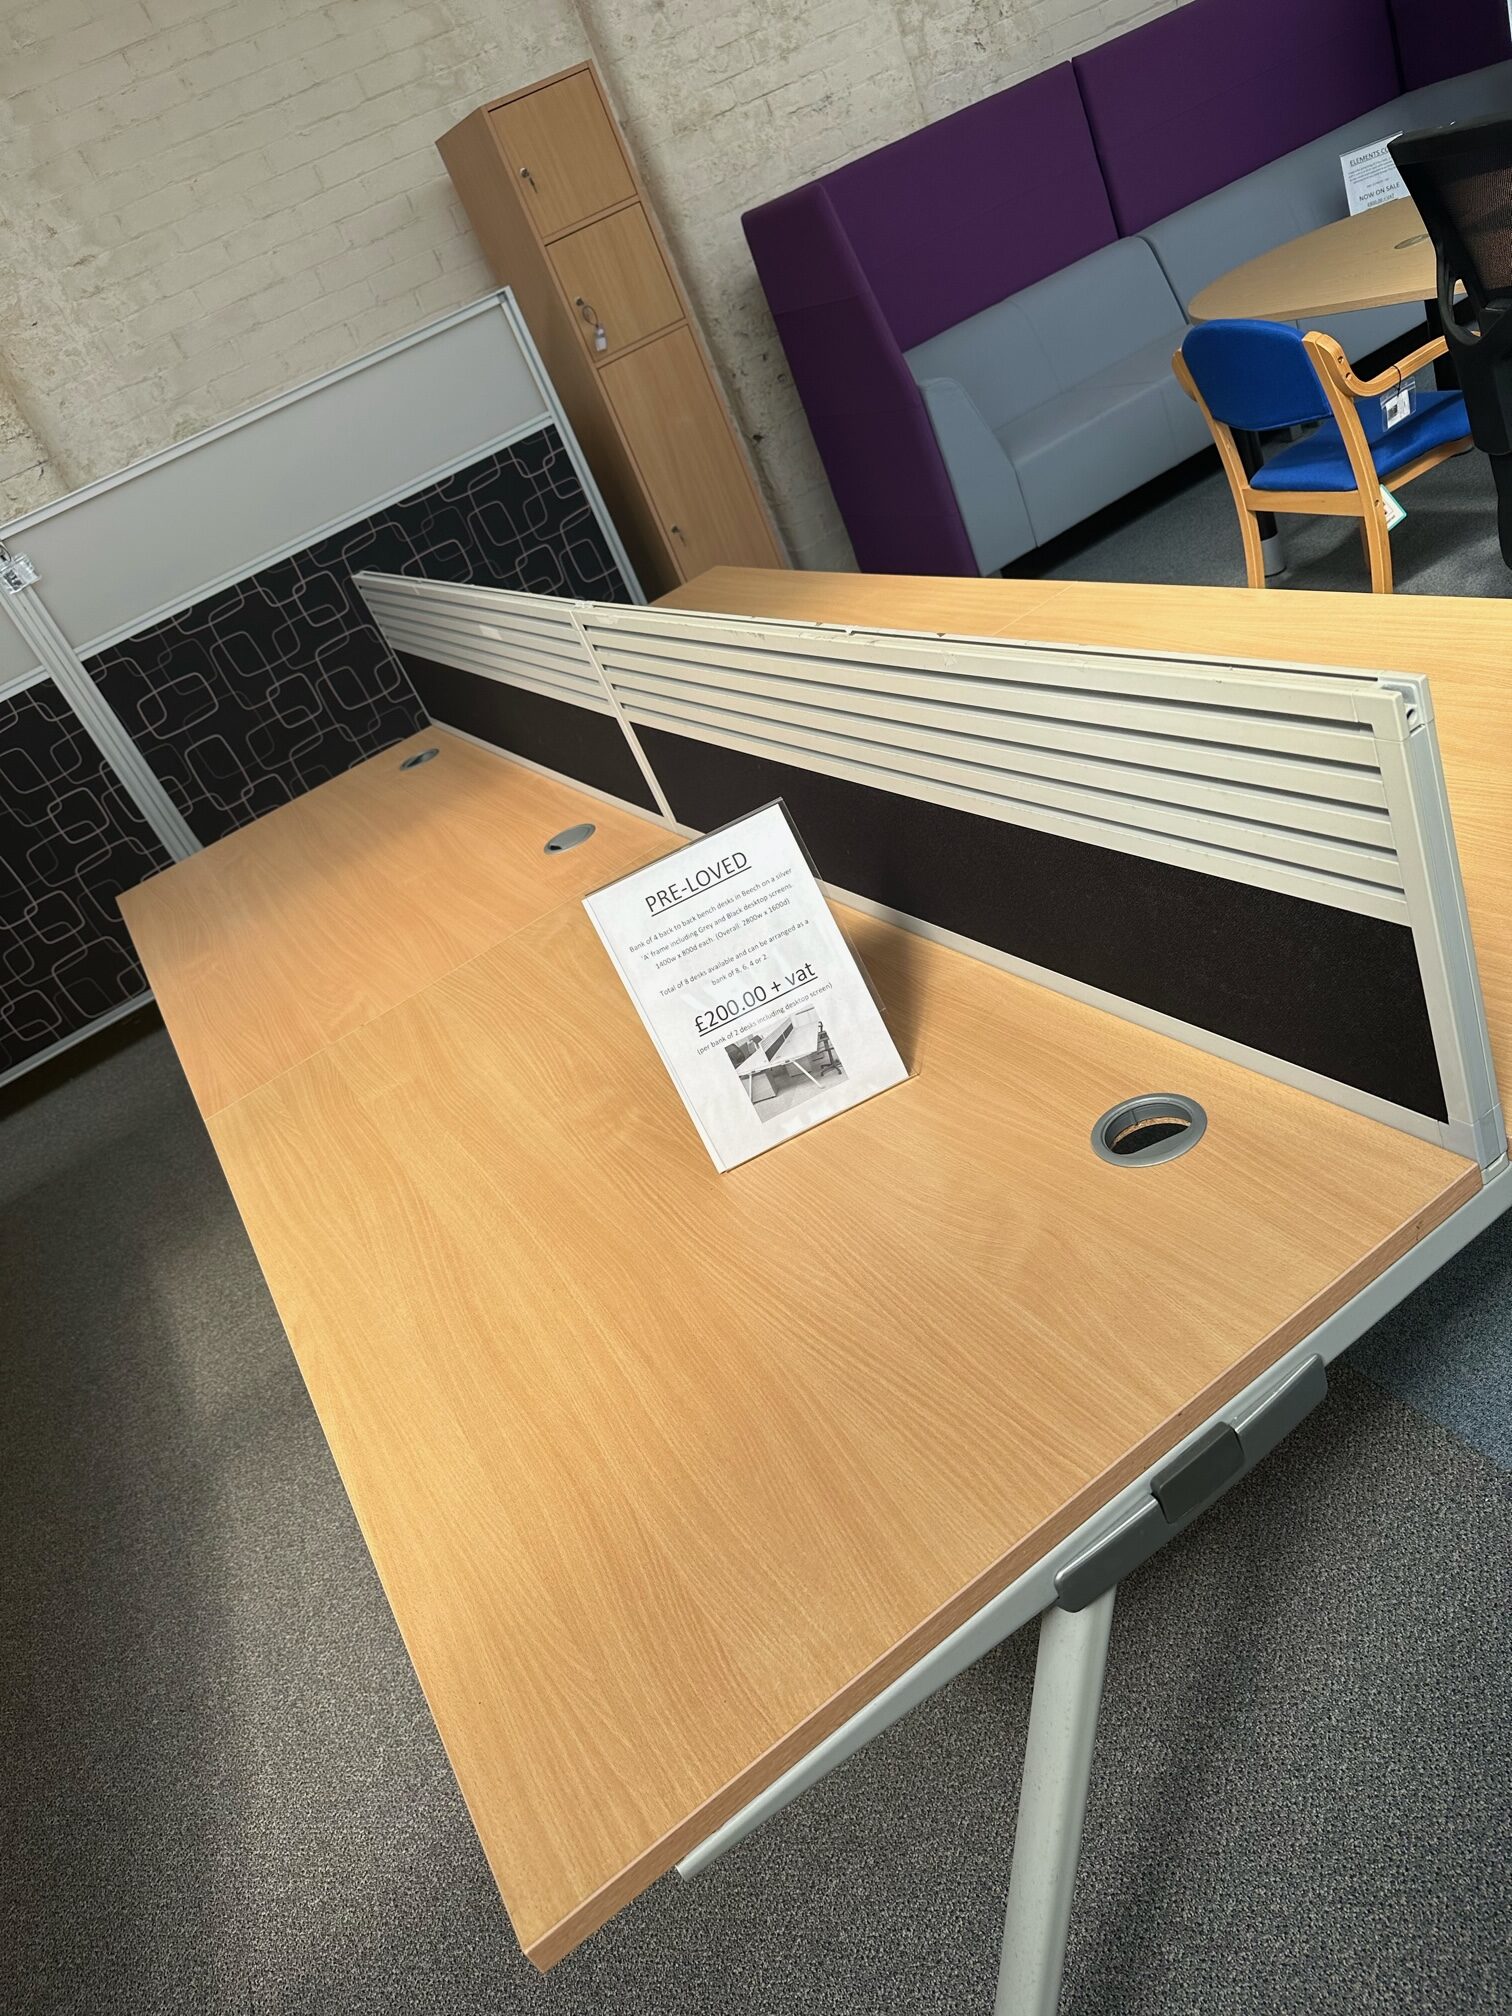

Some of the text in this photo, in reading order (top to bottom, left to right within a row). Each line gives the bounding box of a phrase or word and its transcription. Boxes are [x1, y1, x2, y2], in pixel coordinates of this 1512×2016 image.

[1349, 150, 1381, 167] ELEMENTS
[1359, 192, 1375, 201] NOW
[1375, 187, 1385, 196] ON
[1386, 182, 1401, 192] SALE
[629, 941, 646, 953] Bank
[646, 936, 654, 945] of
[658, 928, 675, 939] back
[681, 916, 698, 929] back
[696, 906, 717, 920] bench
[717, 898, 735, 910] desks
[741, 884, 762, 897] Beech
[761, 880, 771, 888] on
[776, 868, 792, 881] silver
[645, 852, 748, 913] PRE-LOVED
[650, 944, 670, 958] frame
[670, 931, 699, 948] including
[698, 923, 714, 934] Grey
[714, 915, 727, 927] and
[726, 907, 744, 920] Black
[744, 896, 769, 912] desktop
[656, 956, 677, 970] 1400w
[682, 944, 699, 957] 800d
[742, 913, 763, 927] 2800w
[659, 985, 677, 997] Total
[677, 980, 684, 989] of
[690, 971, 708, 983] desks
[708, 957, 735, 974] available
[735, 949, 748, 960] and
[748, 945, 760, 954] can
[759, 940, 769, 948] be
[769, 925, 797, 943] arranged
[711, 974, 728, 986] bank
[728, 969, 735, 978] of
[755, 957, 762, 965] or
[695, 963, 816, 1034] £200.00 + vat
[697, 1044, 711, 1056] (per
[710, 1036, 727, 1048] bank
[725, 1031, 734, 1040] of
[739, 1022, 758, 1034] desks
[757, 1007, 786, 1025] including
[785, 995, 810, 1011] desktop
[810, 982, 833, 998] screen)
